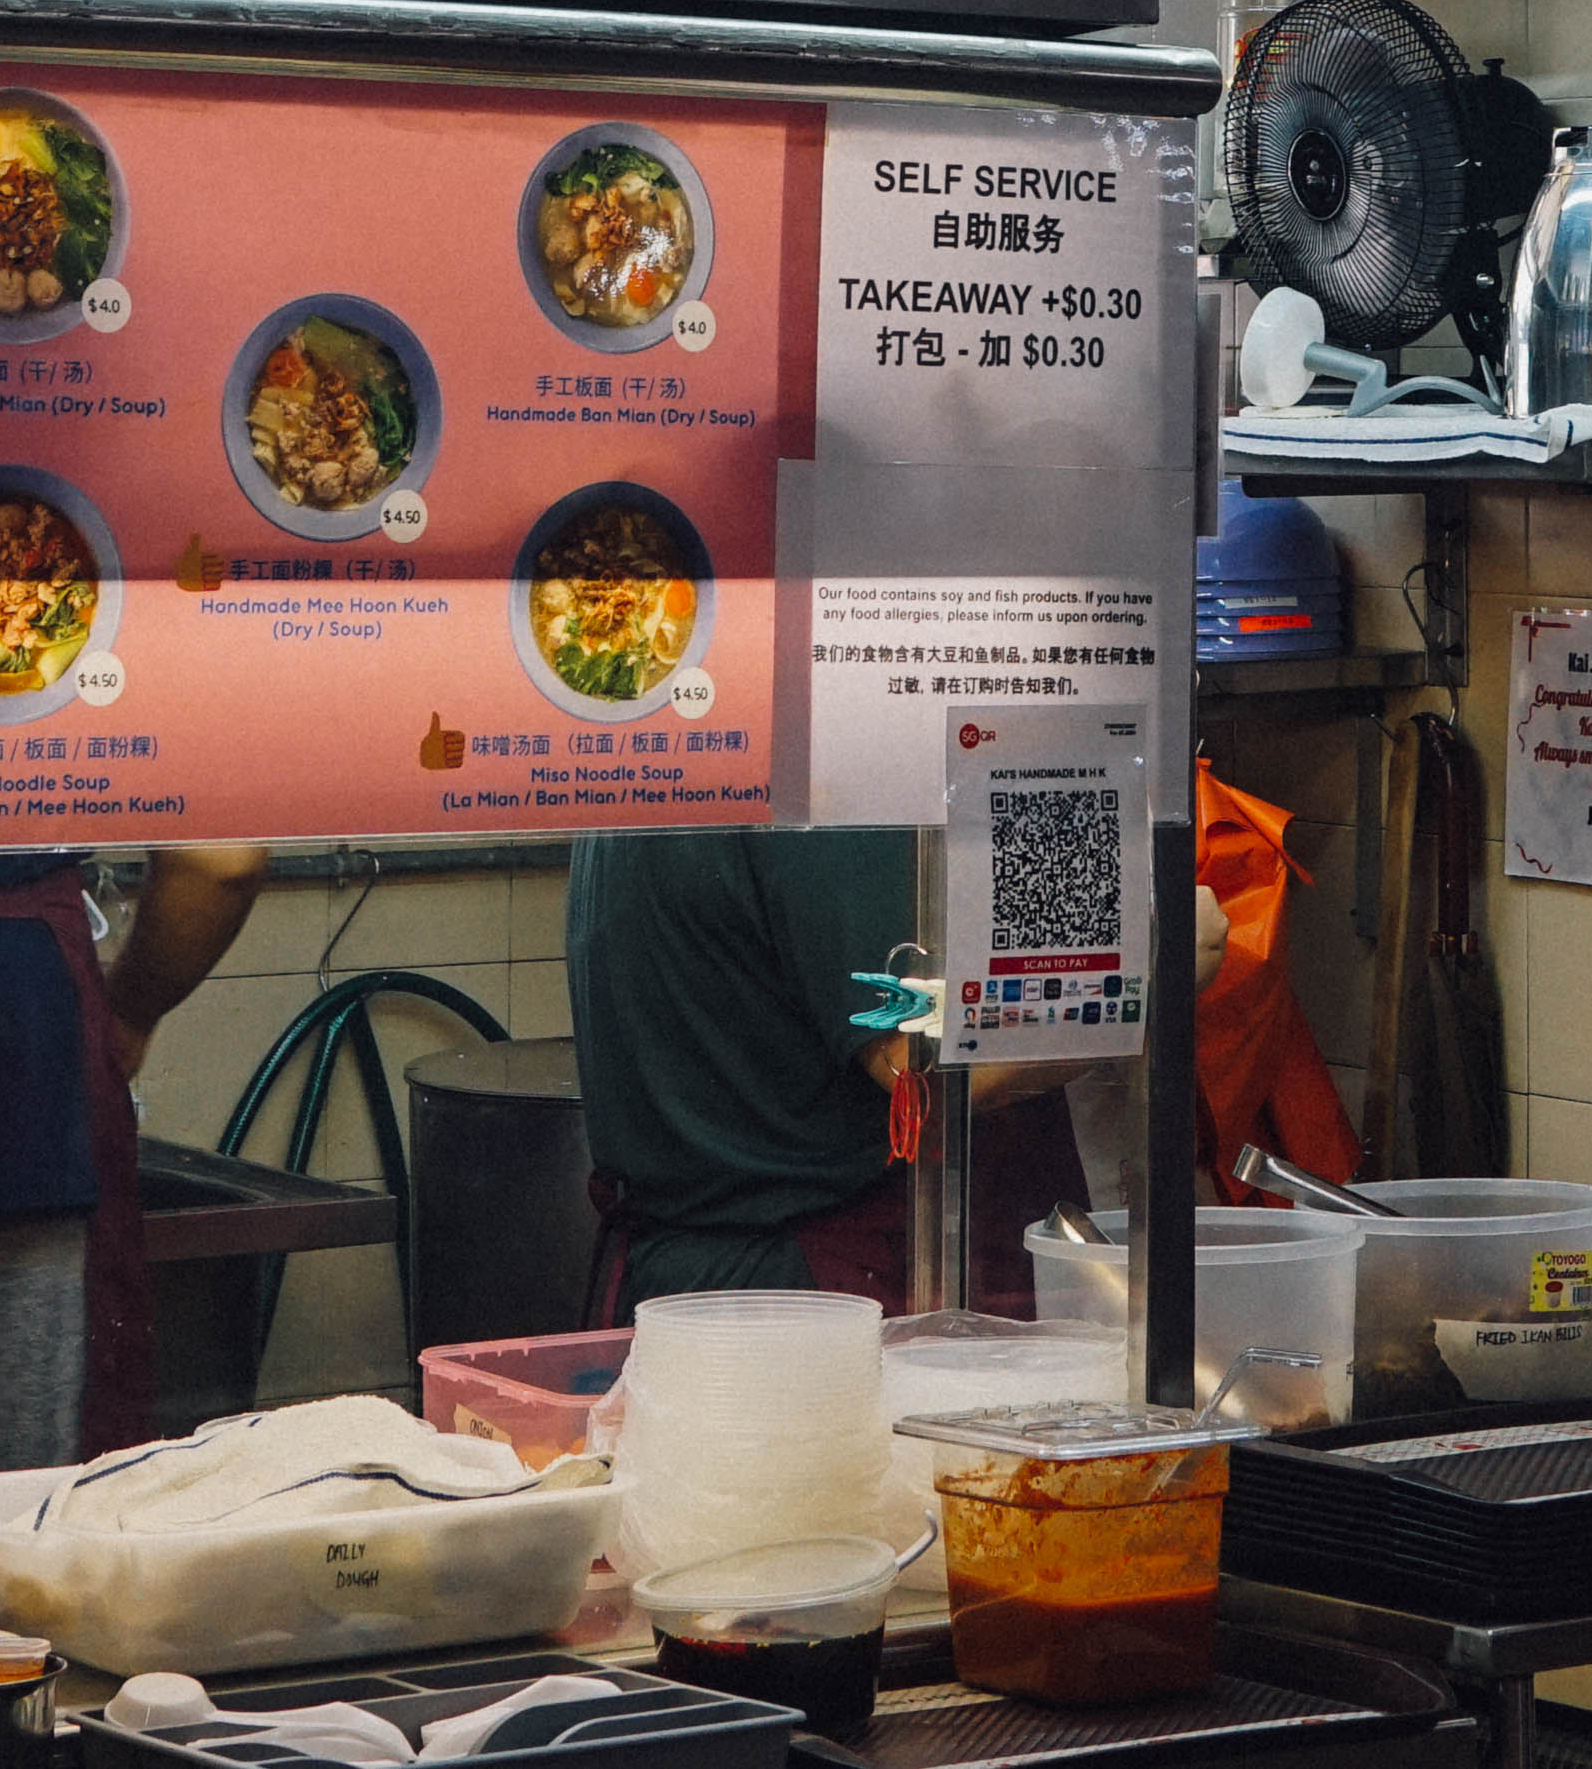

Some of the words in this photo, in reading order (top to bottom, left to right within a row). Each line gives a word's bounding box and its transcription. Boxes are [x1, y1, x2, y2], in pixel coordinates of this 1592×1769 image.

[874, 160, 963, 195] SELF
[974, 165, 1118, 203] SERVICE
[932, 210, 1065, 254] 自助服务
[838, 278, 1033, 316] TAKEAWAY
[1041, 284, 1143, 322] +$0.30
[876, 326, 946, 367] 打包
[978, 330, 1012, 368] 加
[1023, 334, 1105, 370] $0.30
[535, 375, 613, 398] 手工板面
[0, 395, 46, 414] Mian
[51, 396, 94, 418] (Dry
[111, 397, 166, 418] Soup)
[486, 406, 576, 423] Handmade
[581, 407, 612, 422] Ban
[617, 407, 656, 424] Mian
[660, 408, 695, 427] (Dry
[709, 410, 756, 429] Soup)
[230, 559, 333, 581] 手工面粉粿
[201, 598, 302, 614] Handmade
[307, 598, 344, 614] Mee
[350, 598, 397, 614] Hoon
[403, 598, 449, 613] Kueh
[818, 586, 844, 600] Our
[847, 587, 877, 600] food
[880, 588, 936, 601] contains
[941, 590, 964, 604] soy
[967, 589, 992, 602] and
[995, 589, 1019, 603] fish
[1022, 590, 1082, 607] products.
[1085, 591, 1095, 603] If
[1096, 593, 1119, 608] you
[1123, 591, 1154, 605] have
[823, 609, 847, 623] any
[850, 608, 881, 621] food
[884, 608, 944, 624] allergies,
[947, 609, 990, 624] please
[993, 609, 1034, 622] inform
[1037, 613, 1053, 623] us
[1056, 613, 1088, 626] upon
[1091, 610, 1148, 627] ordering.
[273, 621, 314, 641] (Dry
[329, 621, 383, 640] Soup)
[23, 737, 67, 761] 板面
[632, 733, 668, 754] 板面
[1534, 741, 1578, 768] Always
[62, 774, 111, 793] Soup
[531, 766, 570, 783] Miso
[575, 765, 636, 782] Noodle
[642, 764, 684, 784] Soup
[990, 769, 1017, 780] KAI'S
[1019, 768, 1076, 780] HANDMADE
[27, 798, 66, 816] Mee
[72, 797, 123, 816] Hoon
[129, 794, 186, 815] Kueh)
[442, 792, 472, 812] (La
[477, 791, 520, 808] Mian
[536, 790, 569, 806] Ban
[575, 789, 616, 806] Mian
[632, 788, 667, 804] Mee
[672, 787, 716, 804] Hoon
[721, 784, 772, 804] Kueh)
[1023, 959, 1052, 970] SCAN
[1054, 958, 1066, 969] TO
[1069, 958, 1089, 969] PAY
[1551, 1254, 1587, 1265] TOYOGO
[1475, 1330, 1517, 1347] FRIED
[1521, 1329, 1552, 1345] IKAN
[335, 1569, 380, 1589] DOUGH
